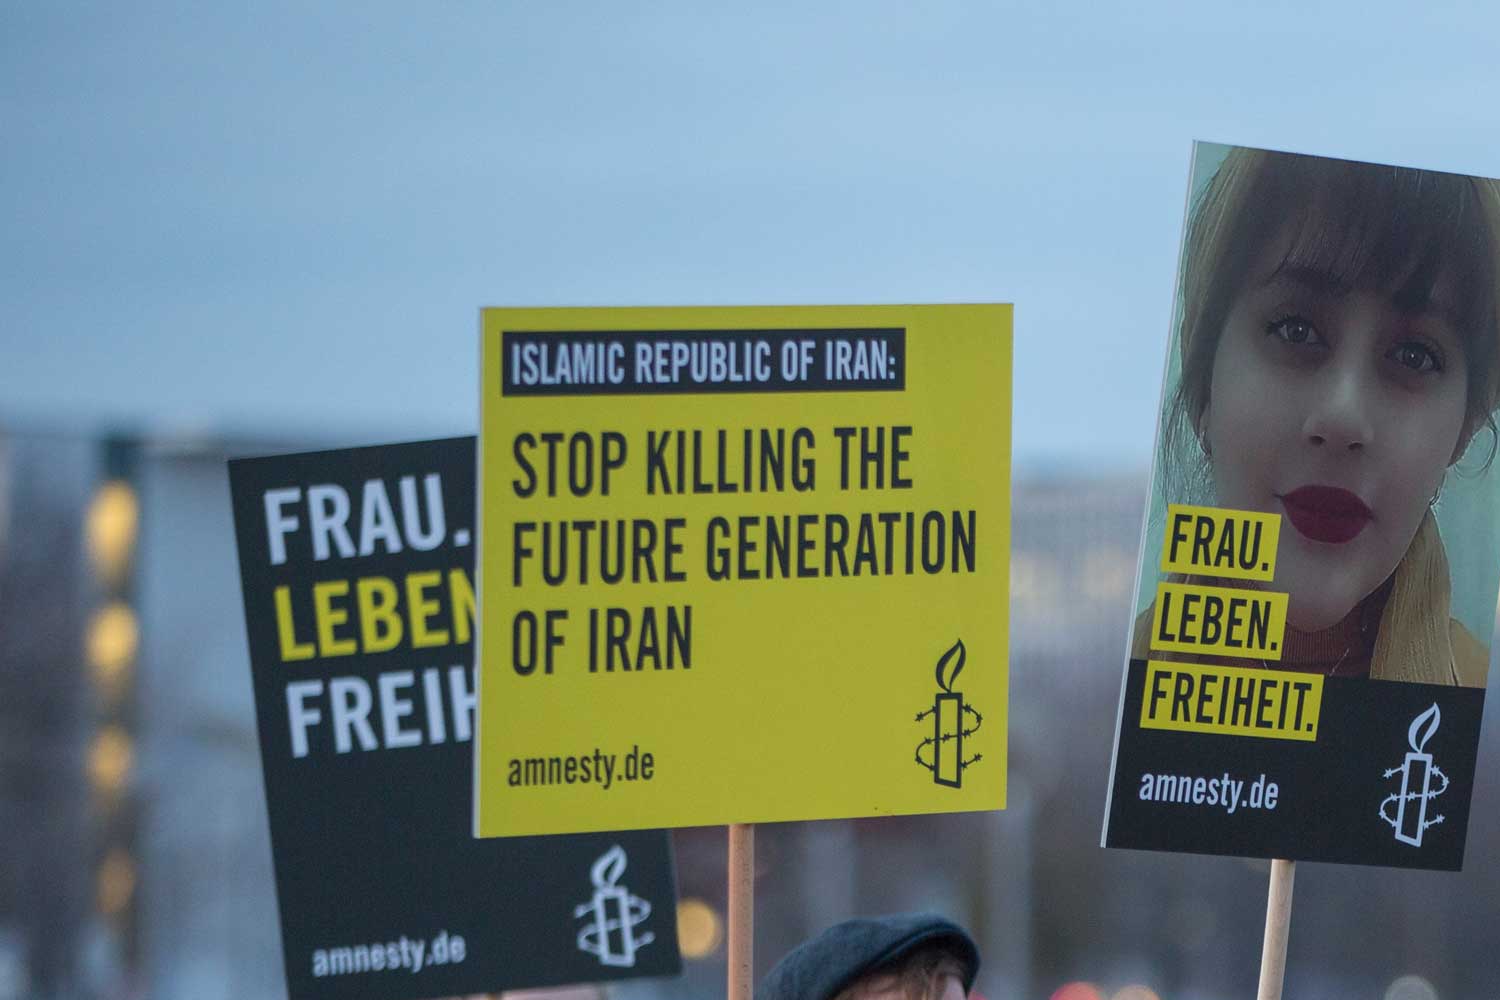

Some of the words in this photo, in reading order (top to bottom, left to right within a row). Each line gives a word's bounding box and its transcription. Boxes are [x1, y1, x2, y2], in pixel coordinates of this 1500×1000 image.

[511, 341, 624, 385] ISLAMIC
[635, 339, 771, 384] REPUBLIC
[781, 340, 816, 382] OF
[825, 340, 896, 381] IRAN:
[512, 431, 626, 498] STOP
[646, 426, 816, 494] KILLING
[835, 425, 913, 491] THE
[264, 473, 470, 564] FRAU.
[513, 518, 687, 587] FUTURE
[707, 509, 976, 581] GENERATION
[1169, 514, 1269, 571] FRAU.
[512, 609, 567, 676] OF
[589, 605, 692, 672] IRAN
[1159, 592, 1278, 651] LEBEN.
[1148, 670, 1313, 732] FREIHEIT.
[508, 747, 654, 789] amnesty.de
[1139, 772, 1278, 813] amnesty.de
[313, 932, 466, 977] amnesty.de
